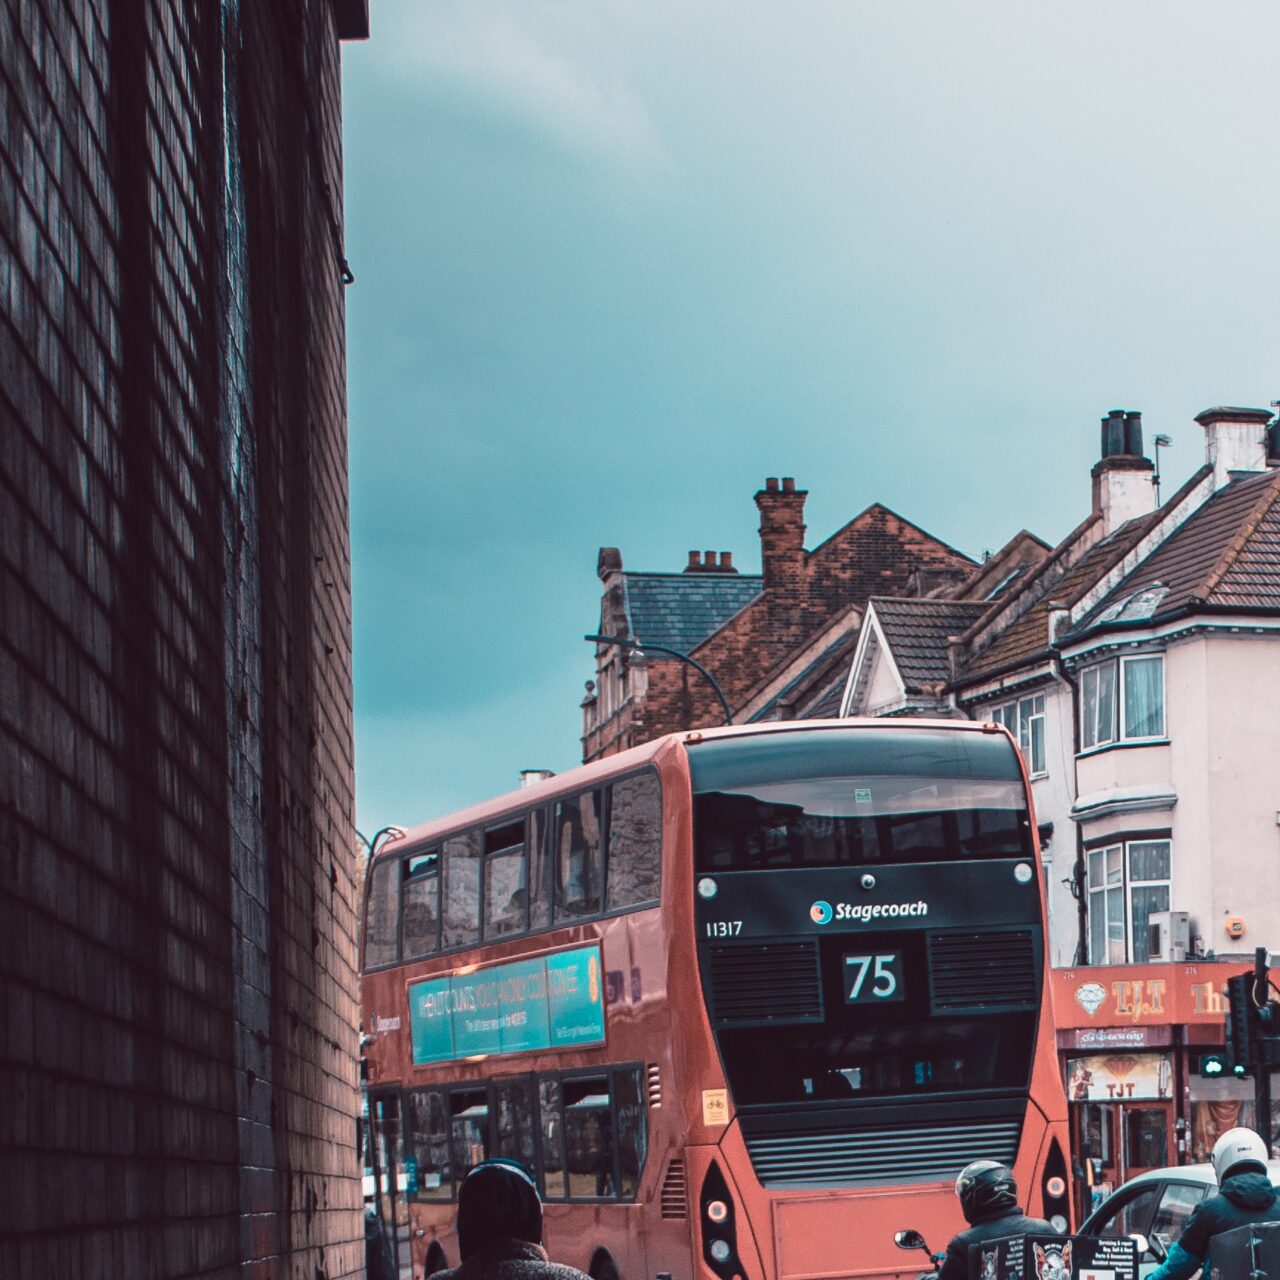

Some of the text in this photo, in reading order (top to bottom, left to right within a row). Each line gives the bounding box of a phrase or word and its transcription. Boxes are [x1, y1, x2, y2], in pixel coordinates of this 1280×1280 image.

[836, 901, 928, 922] Stagecoach
[706, 921, 743, 937] 11317
[845, 955, 897, 999] 75
[1106, 1082, 1135, 1098] TJT
